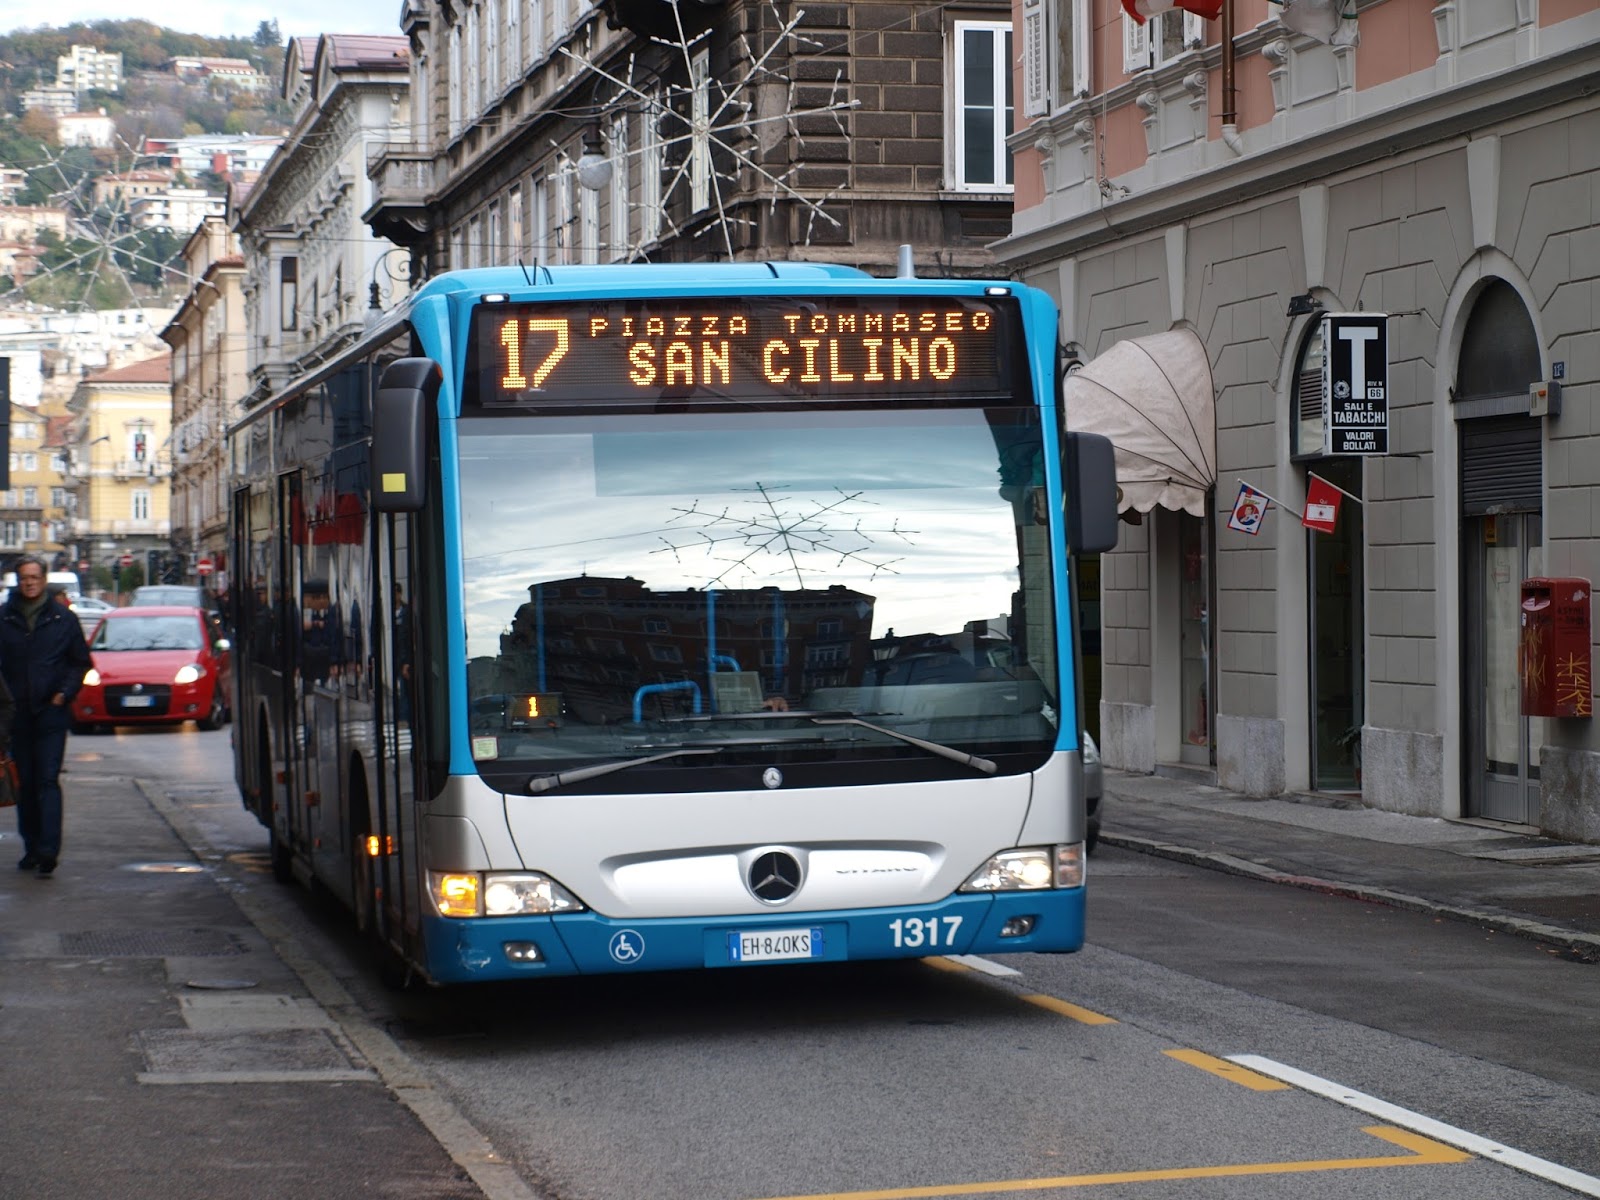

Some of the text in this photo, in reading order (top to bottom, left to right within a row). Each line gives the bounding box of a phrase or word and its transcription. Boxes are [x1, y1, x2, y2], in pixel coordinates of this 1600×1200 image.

[590, 312, 990, 337] PIAZZA TOMMASEO
[500, 318, 569, 389] 17
[628, 337, 956, 386] SAN CILINO
[1339, 327, 1378, 399] T
[1370, 388, 1382, 398] 66
[1344, 402, 1373, 411] SALI E
[1333, 411, 1385, 424] TABACCHI
[1343, 441, 1376, 451] BOLLATI
[1345, 431, 1375, 441] VALORI
[528, 696, 539, 717] 1
[889, 916, 963, 947] 1317
